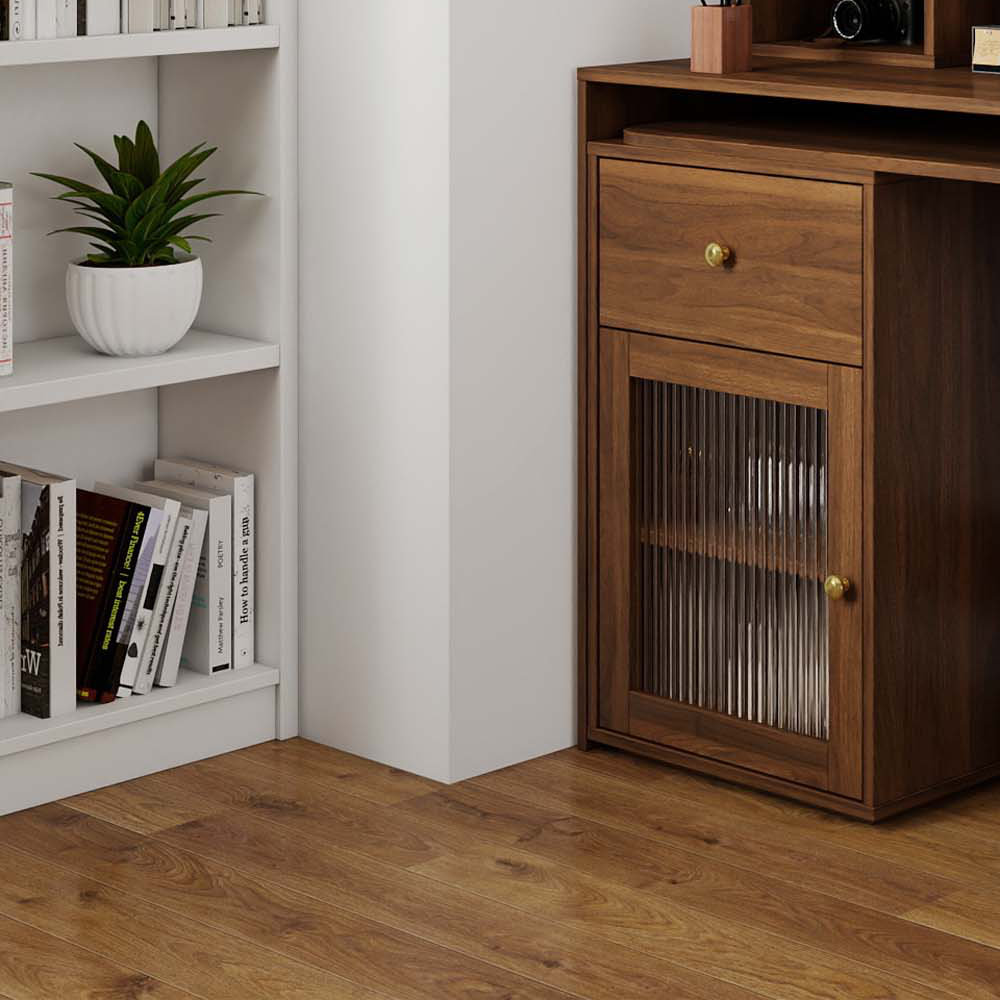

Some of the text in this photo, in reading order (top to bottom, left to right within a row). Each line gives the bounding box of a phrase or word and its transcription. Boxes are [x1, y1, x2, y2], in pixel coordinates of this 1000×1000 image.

[239, 547, 248, 584] handle
[240, 585, 248, 596] to
[239, 599, 248, 623] How
